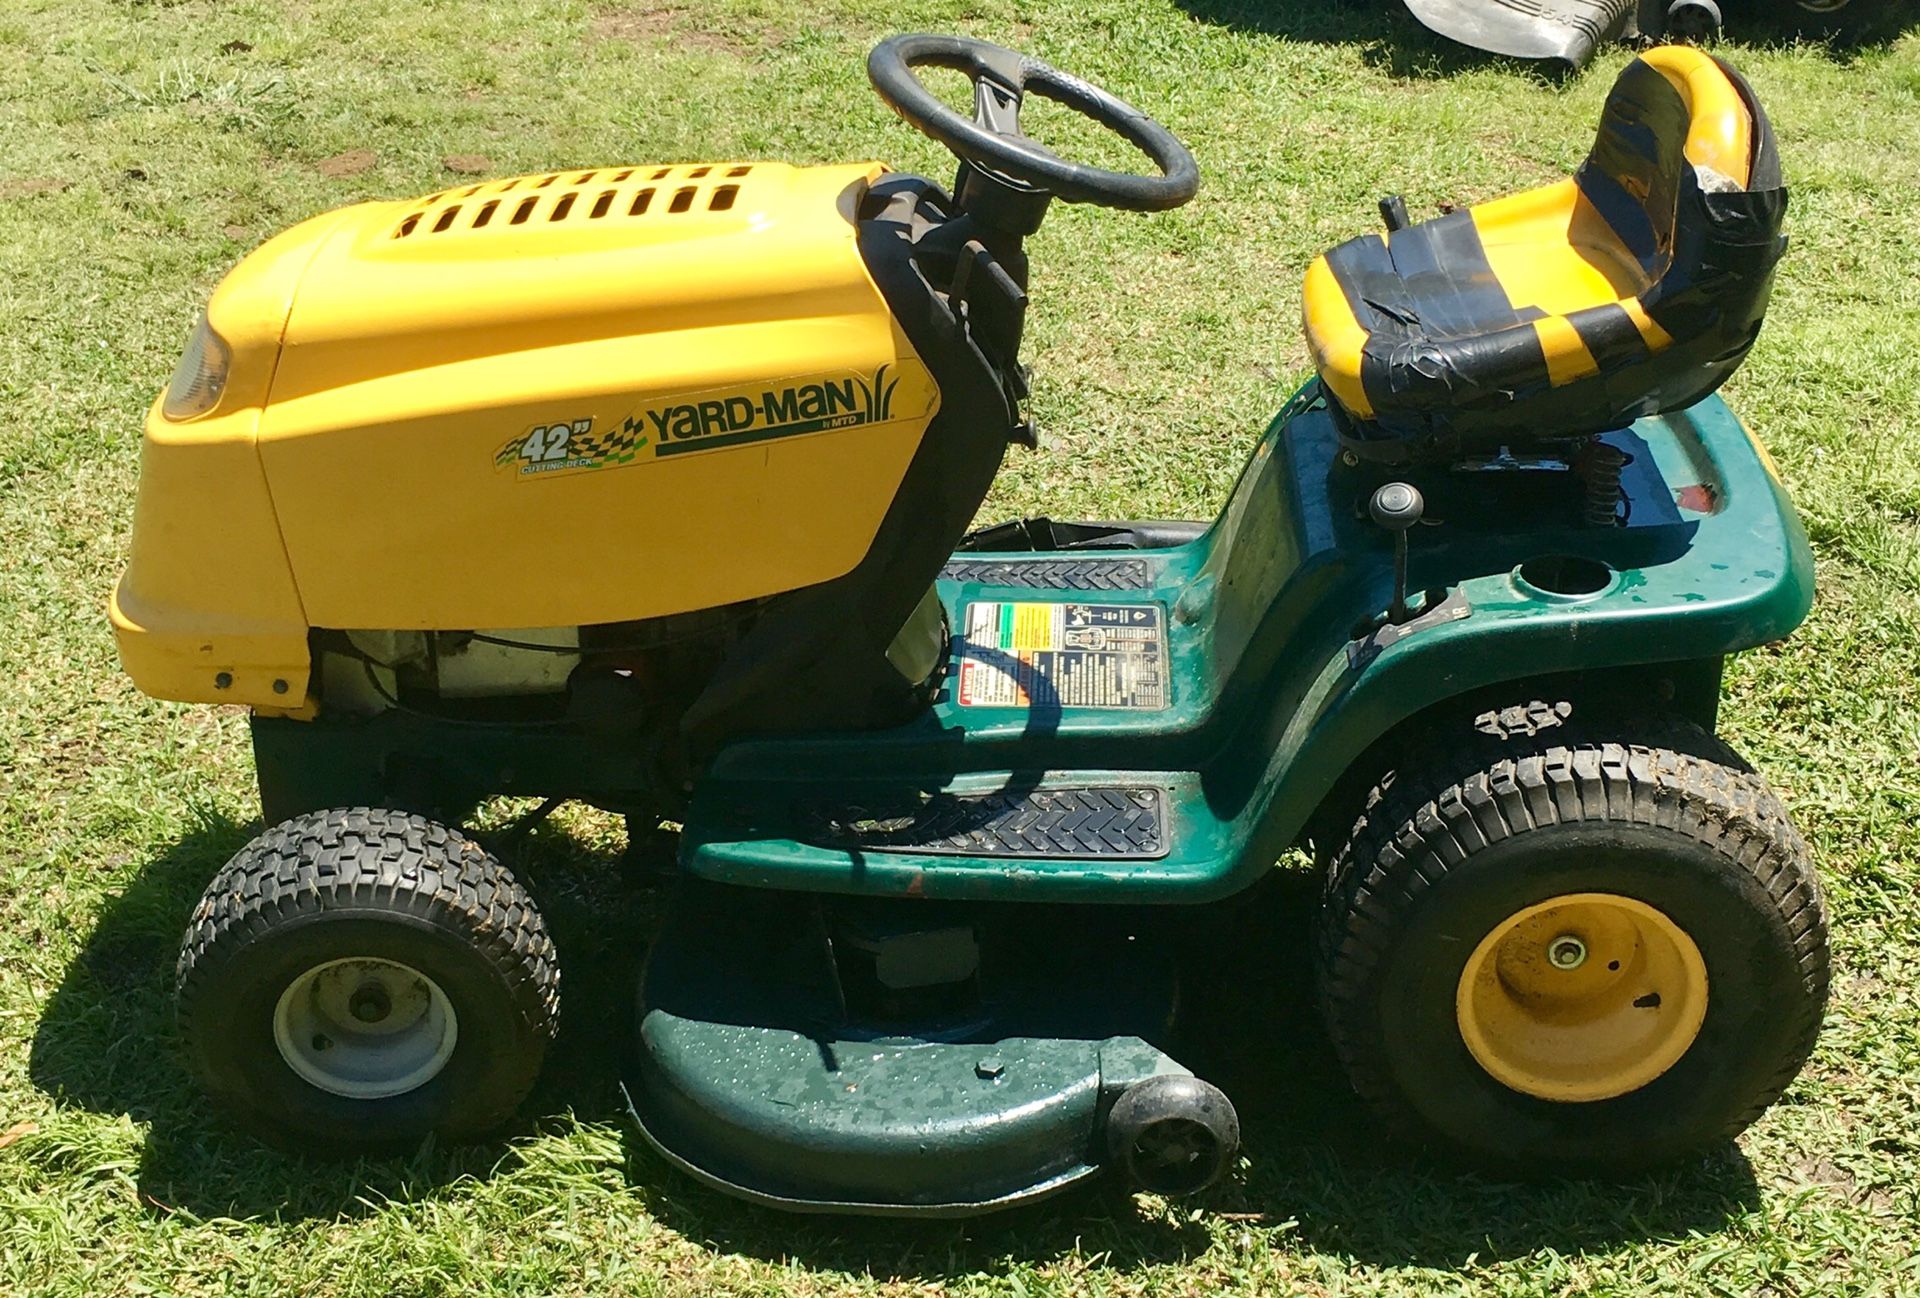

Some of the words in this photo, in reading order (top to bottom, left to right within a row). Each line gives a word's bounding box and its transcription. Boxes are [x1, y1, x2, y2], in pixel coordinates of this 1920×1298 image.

[832, 416, 857, 428] MTD
[521, 461, 564, 474] CUTTING
[566, 457, 594, 468] DECK
